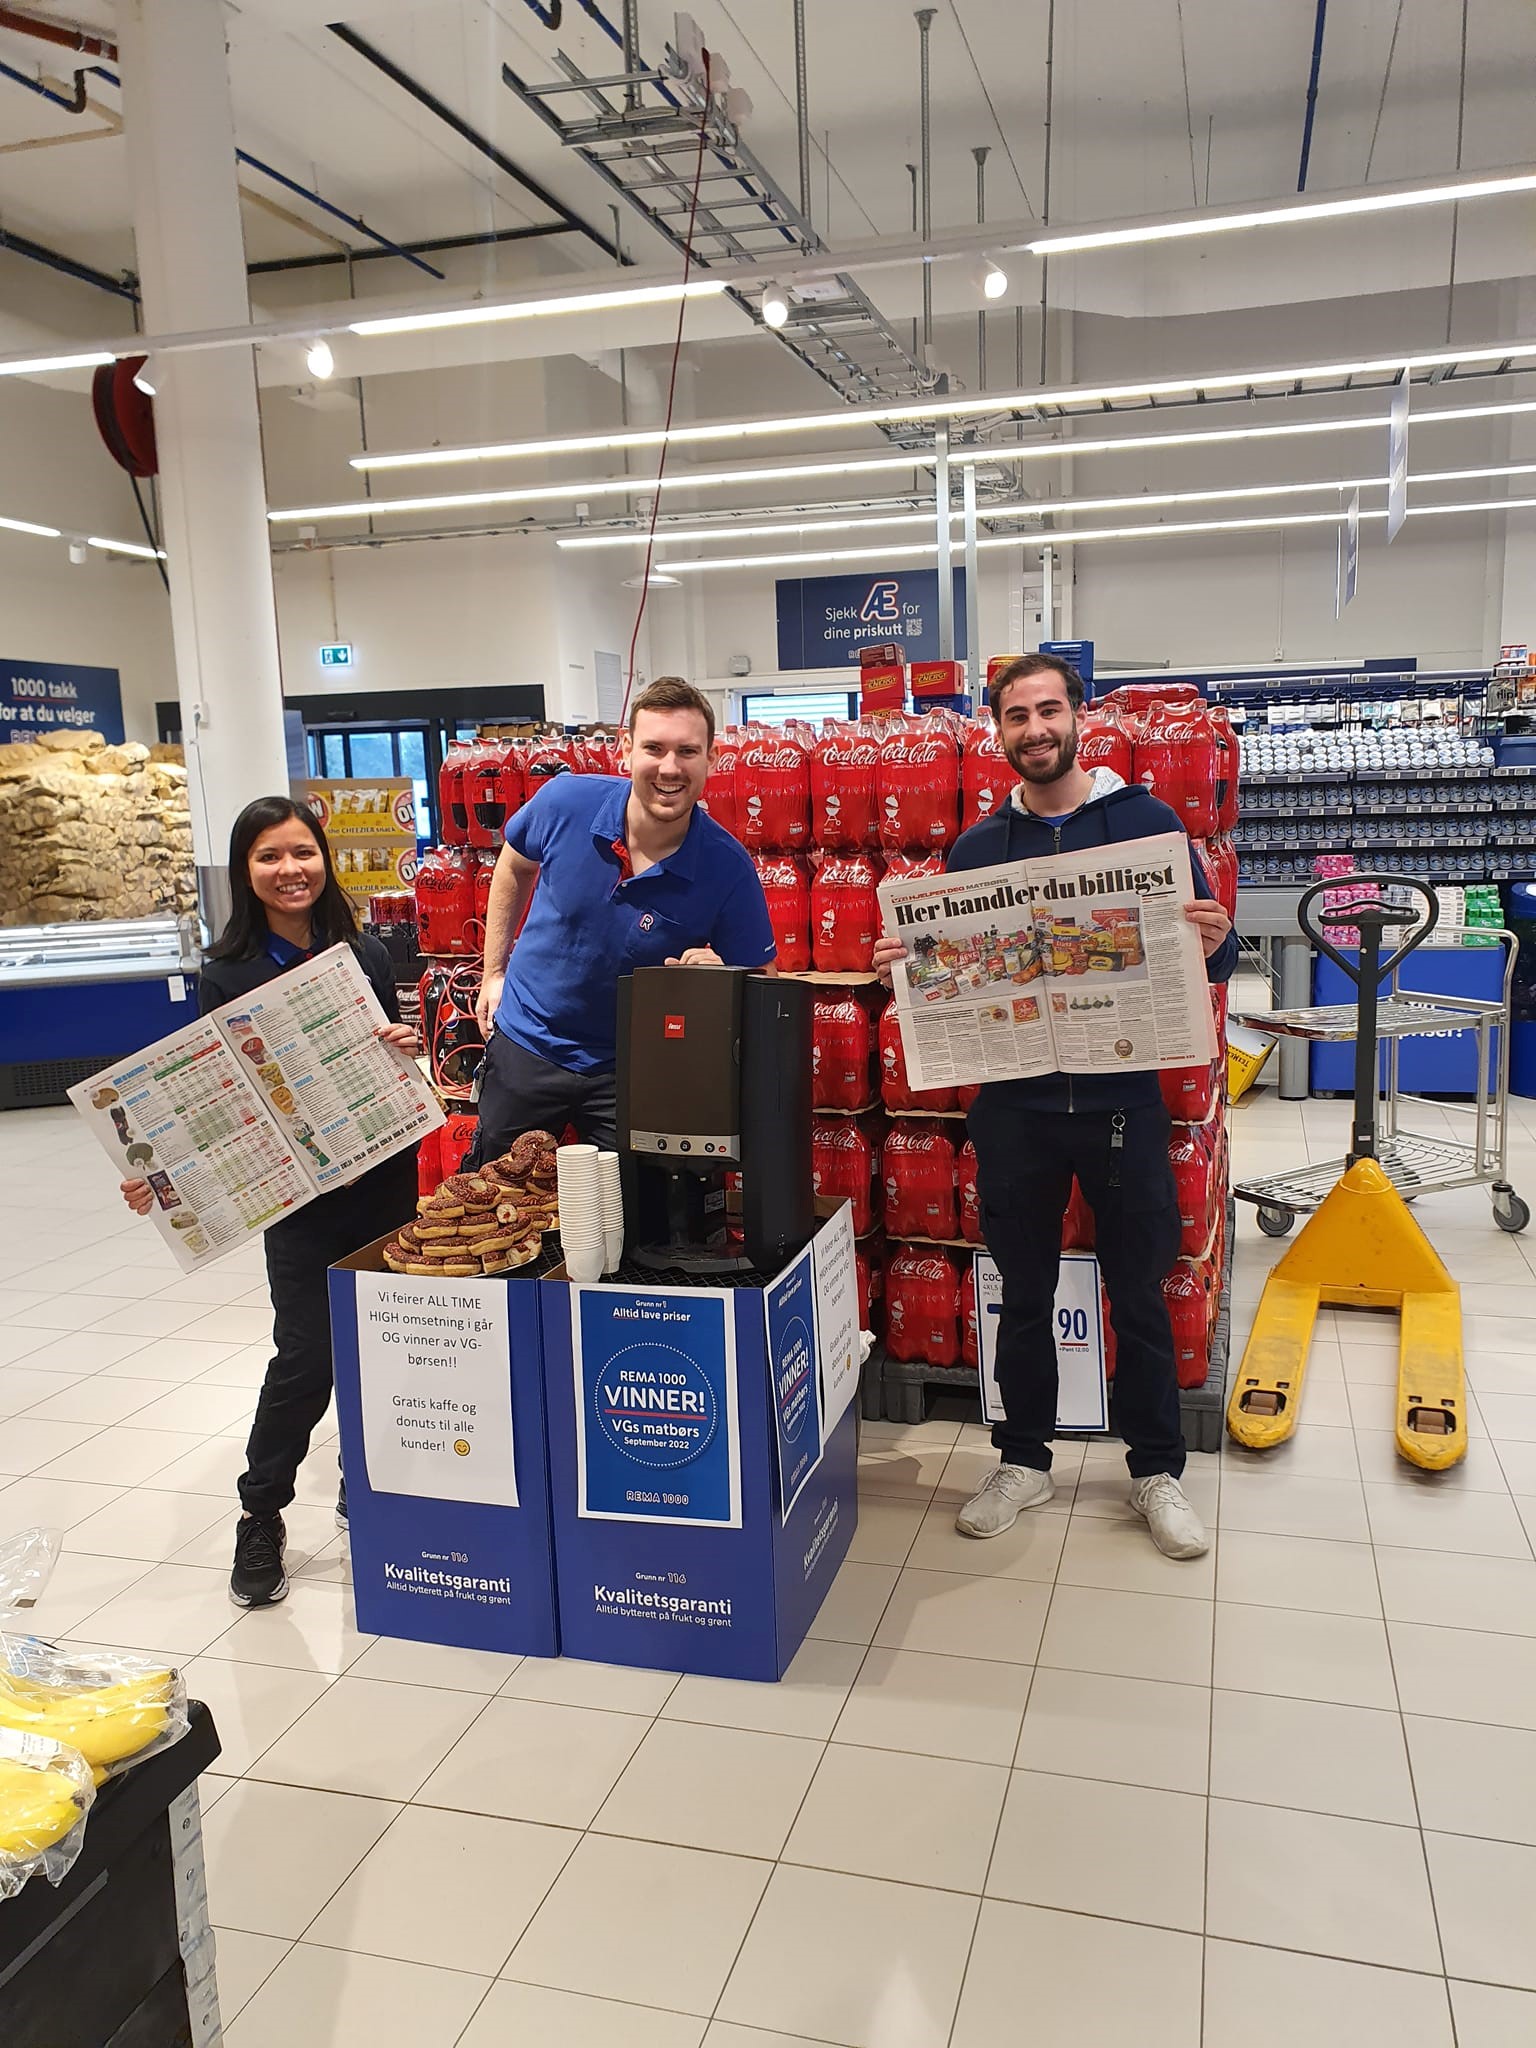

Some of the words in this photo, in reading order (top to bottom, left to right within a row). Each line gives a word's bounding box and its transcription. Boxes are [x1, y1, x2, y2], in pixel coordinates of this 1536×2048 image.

[825, 606, 858, 622] Sjekk
[860, 580, 900, 621] Æ
[902, 602, 921, 615] for
[823, 627, 851, 640] dine
[853, 623, 903, 640] priskutt
[11, 677, 46, 697] 1000
[48, 681, 78, 699] takk
[20, 704, 35, 721] at
[36, 704, 54, 722] du
[56, 706, 96, 726] velger
[894, 903, 940, 926] Her
[942, 885, 1040, 918] handler
[1043, 878, 1077, 900] du
[1078, 864, 1176, 896] billigst
[378, 1291, 390, 1302] Vi
[393, 1292, 424, 1305] feirer
[427, 1295, 449, 1307] ALL
[451, 1296, 482, 1309] TIME
[635, 1299, 655, 1307] Grunn
[369, 1310, 399, 1323] HIGH
[402, 1315, 465, 1331] omsetning
[467, 1317, 471, 1329] i
[474, 1318, 493, 1332] går
[612, 1307, 639, 1319] Alltid
[641, 1310, 661, 1320] lave
[663, 1311, 691, 1322] priser
[1057, 1308, 1088, 1340] 90
[381, 1331, 400, 1343] OG
[403, 1333, 440, 1347] vinner
[443, 1339, 457, 1348] av
[460, 1338, 482, 1350] VG-
[407, 1353, 457, 1368] børsen!!
[620, 1370, 656, 1384] REMA
[658, 1372, 687, 1386] 1000
[778, 1345, 809, 1400] VINNER!
[392, 1395, 426, 1409] Gratis
[430, 1398, 458, 1412] kaffe
[462, 1404, 477, 1416] og
[604, 1384, 705, 1413] VINNER!
[396, 1415, 436, 1429] donuts
[439, 1420, 450, 1431] til
[454, 1421, 475, 1433] alle
[612, 1418, 640, 1434] VGs
[643, 1423, 700, 1438] matbørs
[400, 1437, 446, 1452] kunder!
[624, 1436, 667, 1448] September
[668, 1439, 690, 1450] 2022
[626, 1490, 661, 1503] REMA
[662, 1493, 689, 1504] 1000
[421, 1551, 441, 1560] Grunn
[450, 1551, 469, 1563] 116
[384, 1562, 511, 1593] Kvalitetsgaranti
[635, 1572, 657, 1581] Grunn
[667, 1572, 687, 1584] 116
[386, 1581, 407, 1592] Alltid
[408, 1583, 442, 1597] bytterett
[443, 1589, 454, 1598] på
[456, 1589, 475, 1601] frukt
[477, 1594, 487, 1603] og
[488, 1596, 511, 1605] grønt
[594, 1584, 732, 1615] Kvalitetsgaranti
[596, 1604, 619, 1615] Alltid
[620, 1606, 657, 1619] bytterett
[659, 1612, 670, 1621] på
[672, 1613, 693, 1623] frukt
[694, 1616, 706, 1626] og
[707, 1618, 732, 1628] grønt
